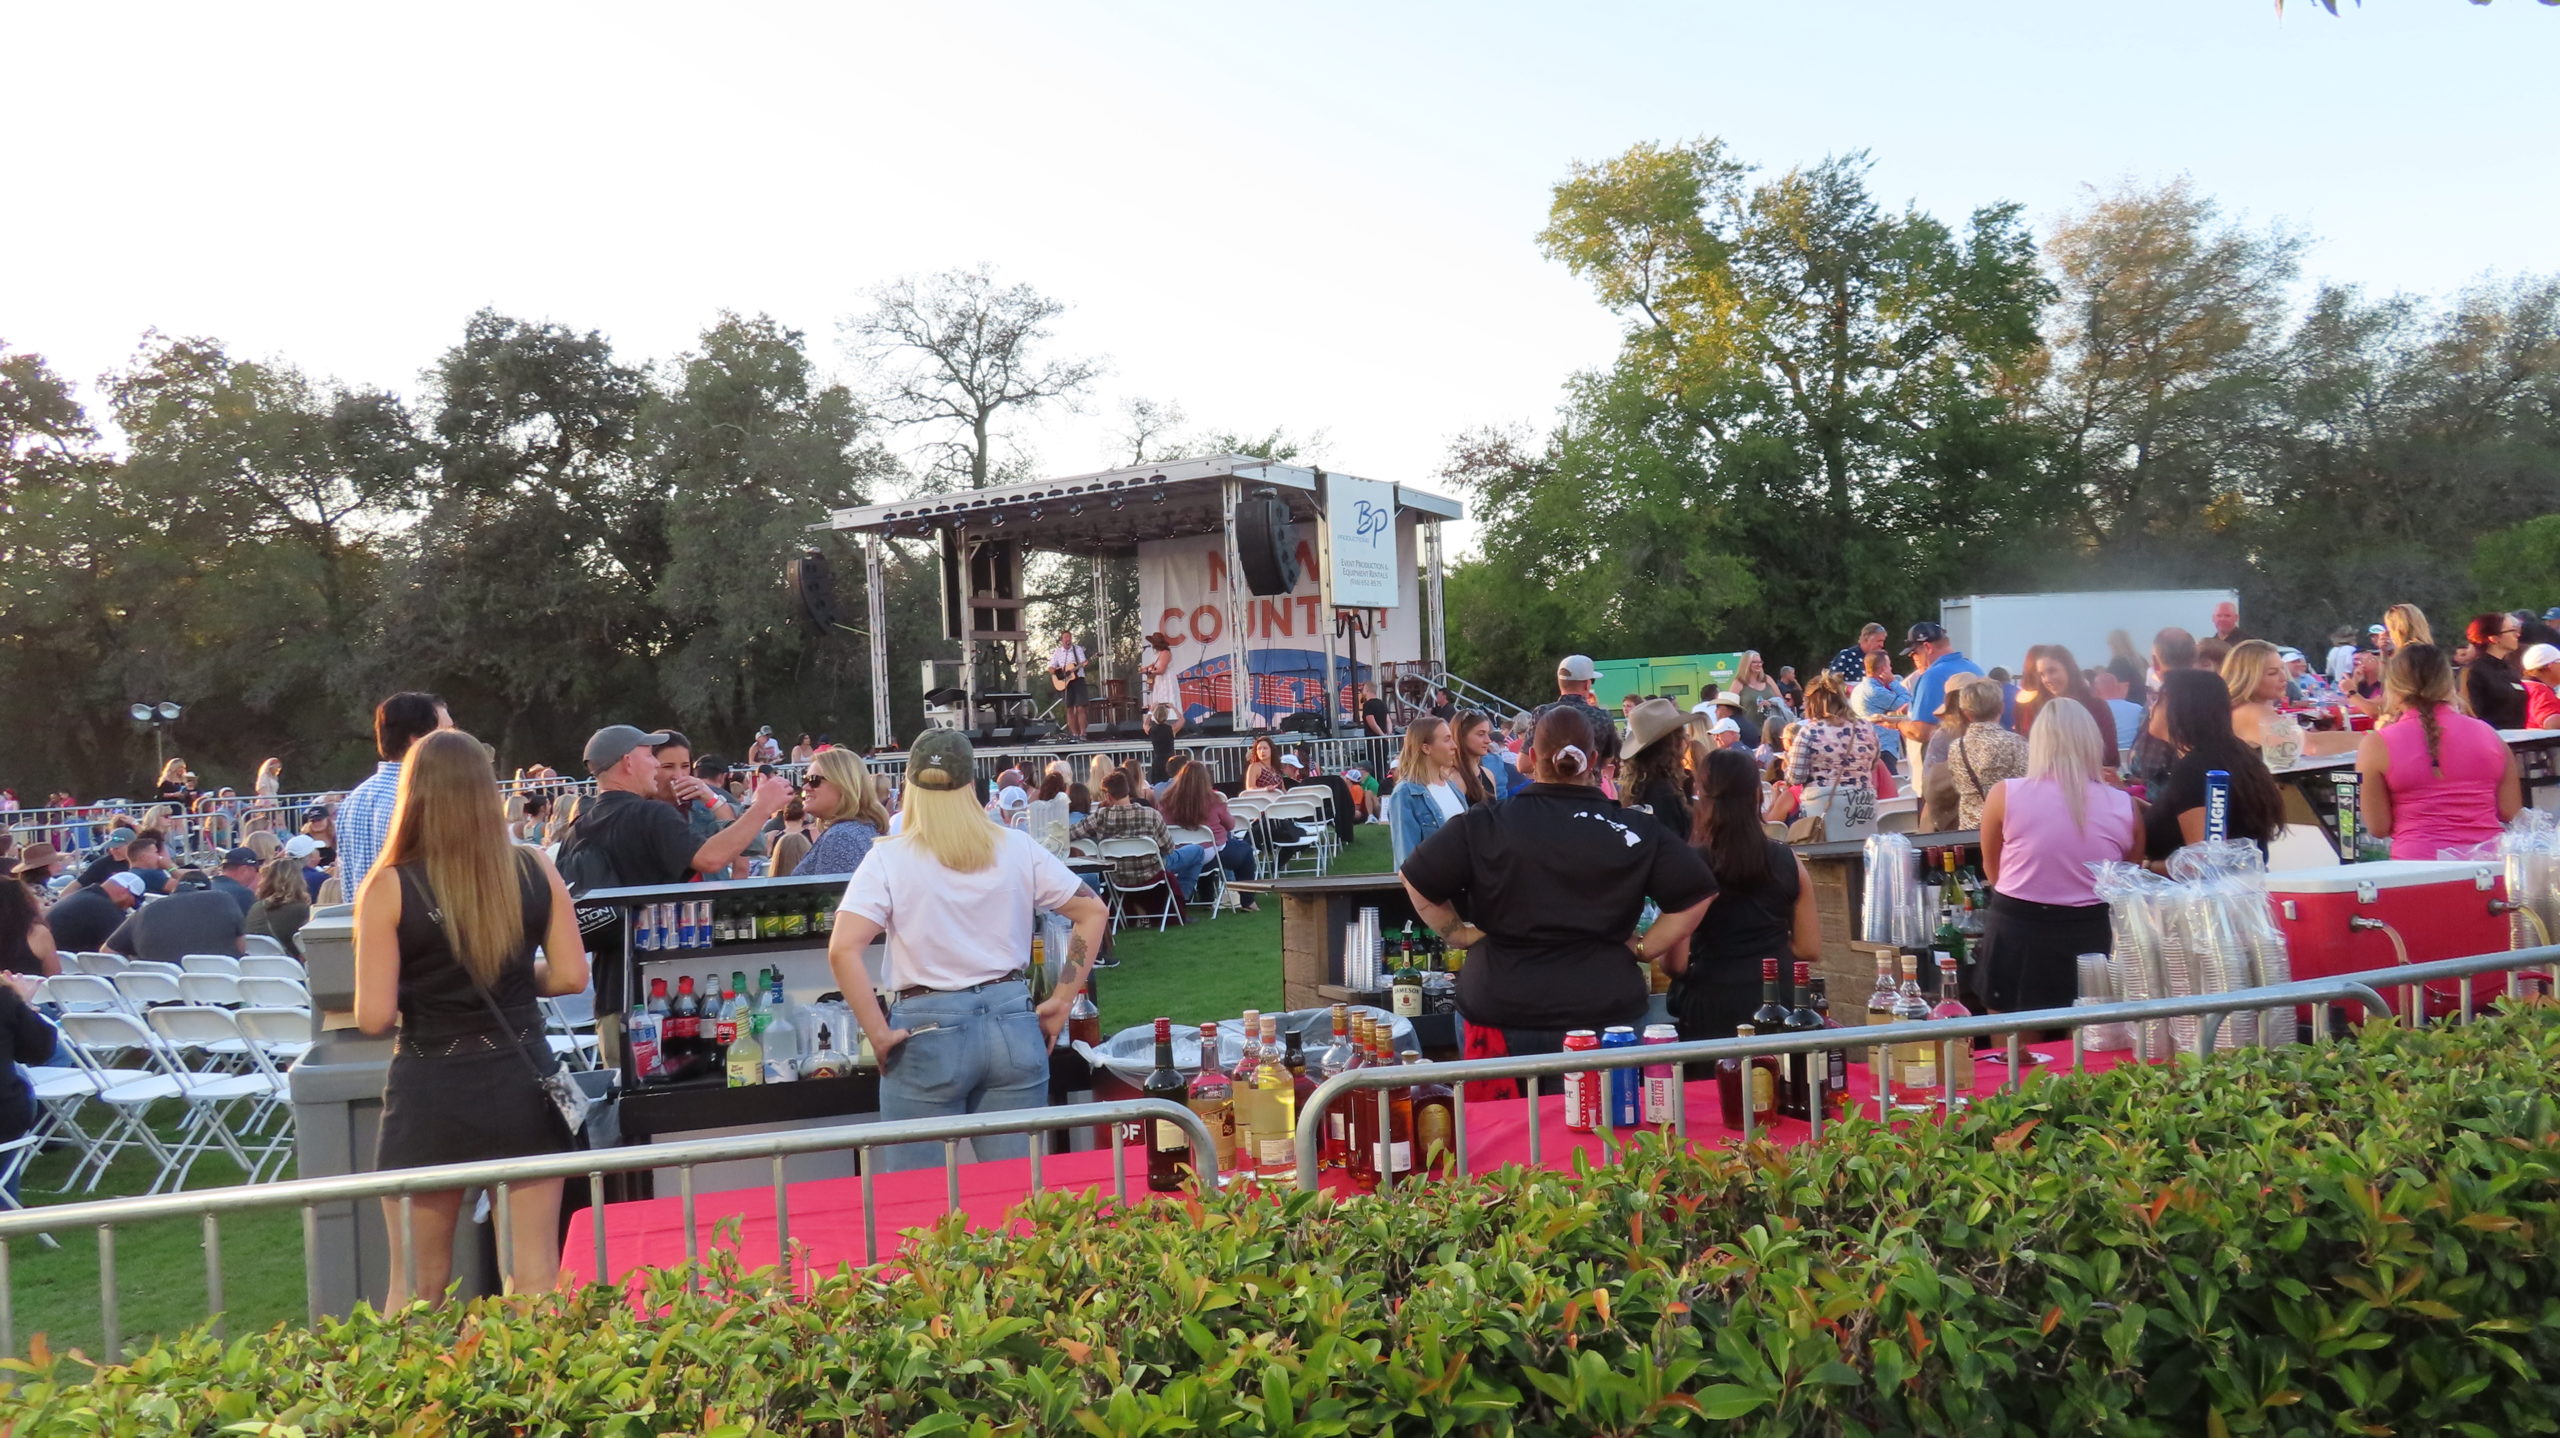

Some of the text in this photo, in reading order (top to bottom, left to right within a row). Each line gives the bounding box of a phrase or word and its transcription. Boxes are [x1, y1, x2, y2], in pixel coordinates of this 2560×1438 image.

[1353, 500, 1388, 549] BP
[2210, 787, 2226, 833] LIGHT
[577, 904, 612, 926] ATION
[1655, 1079, 1664, 1107] SELTZER
